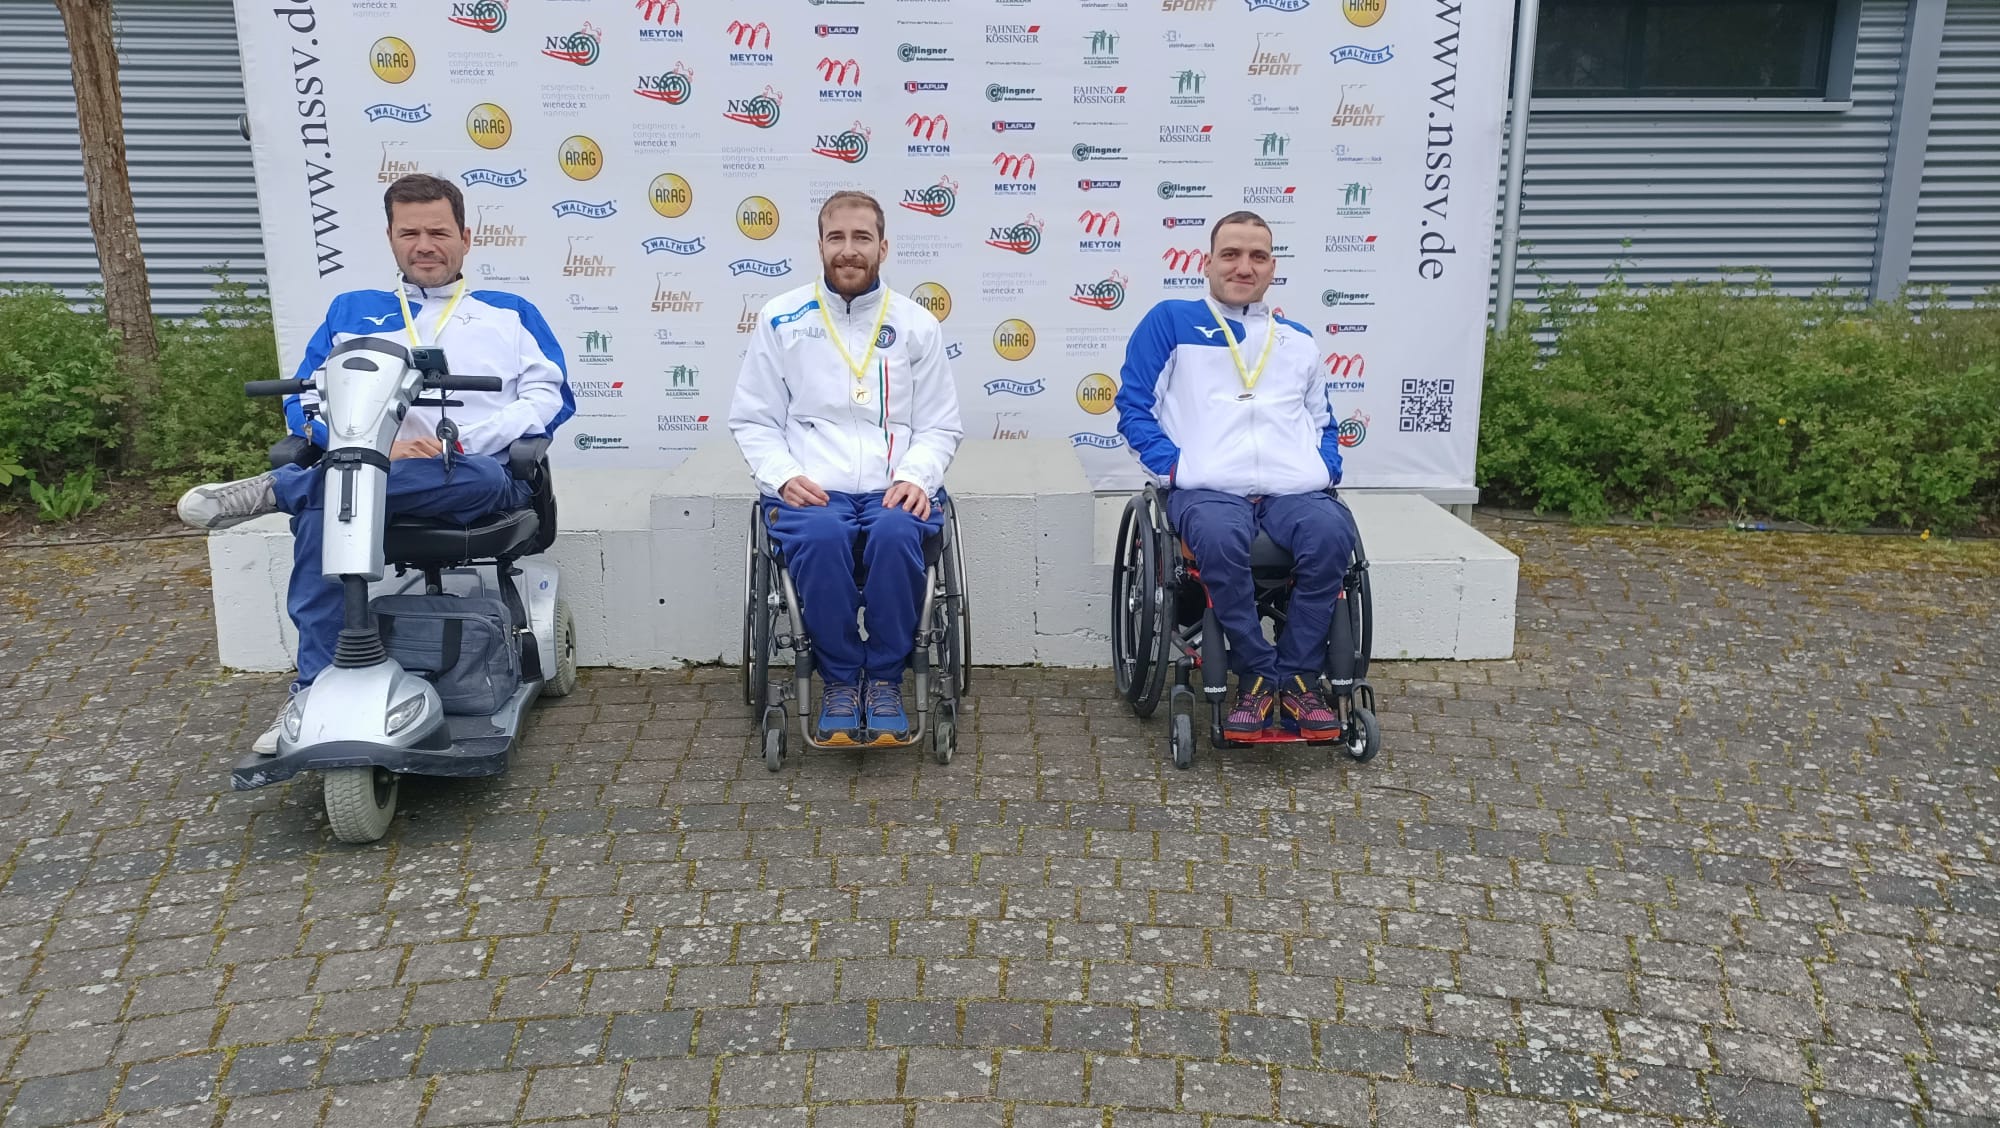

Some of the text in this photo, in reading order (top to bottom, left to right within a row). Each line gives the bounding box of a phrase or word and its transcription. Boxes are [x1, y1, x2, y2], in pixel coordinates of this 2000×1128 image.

[1162, 0, 1216, 11] SPORT
[986, 25, 1026, 33] FAHNEN
[986, 34, 1039, 43] KÖSSINGER
[1259, 53, 1290, 63] H&N
[1339, 48, 1383, 61] WALTHER
[377, 53, 408, 68] ARAG
[1248, 64, 1302, 75] SPORT
[1074, 86, 1113, 94] FAHNEN
[1074, 95, 1126, 104] KÖSSINGER
[373, 106, 421, 119] WALTHER
[1343, 104, 1374, 114] H&N
[1331, 115, 1385, 126] SPORT
[474, 119, 504, 134] ARAG
[1160, 125, 1199, 133] FAHNEN
[272, 0, 344, 279] www.nssv.d
[1159, 134, 1211, 143] KÖSSINGER
[908, 145, 950, 153] MEYTON
[566, 151, 596, 166] ARAG
[387, 160, 418, 171] H&N
[470, 172, 516, 184] WALTHER
[994, 183, 1036, 191] MEYTON
[1243, 187, 1282, 195] FAHNEN
[655, 188, 685, 203] ARAG
[1243, 195, 1294, 203] KÖSSINGER
[561, 203, 606, 216] WALTHER
[743, 211, 772, 225] ARAG
[483, 225, 514, 235] H&N
[472, 236, 526, 246] SPORT
[1326, 235, 1364, 243] FAHNEN
[651, 239, 695, 252] WALTHER
[1325, 243, 1375, 252] KÖSSINGER
[573, 255, 603, 265] H&N
[563, 266, 616, 277] SPORT
[738, 262, 782, 274] WALTHER
[661, 291, 690, 301] H&N
[651, 301, 703, 312] SPORT
[1000, 333, 1029, 347] ARAG
[571, 381, 610, 389] FAHNEN
[992, 383, 1036, 393] WALTHER
[1083, 387, 1111, 401] ARAG
[657, 415, 695, 423] FAHNEN
[658, 423, 708, 431] KÖSSINGER
[999, 430, 1029, 440] H&N
[1074, 436, 1116, 446] WALTHER
